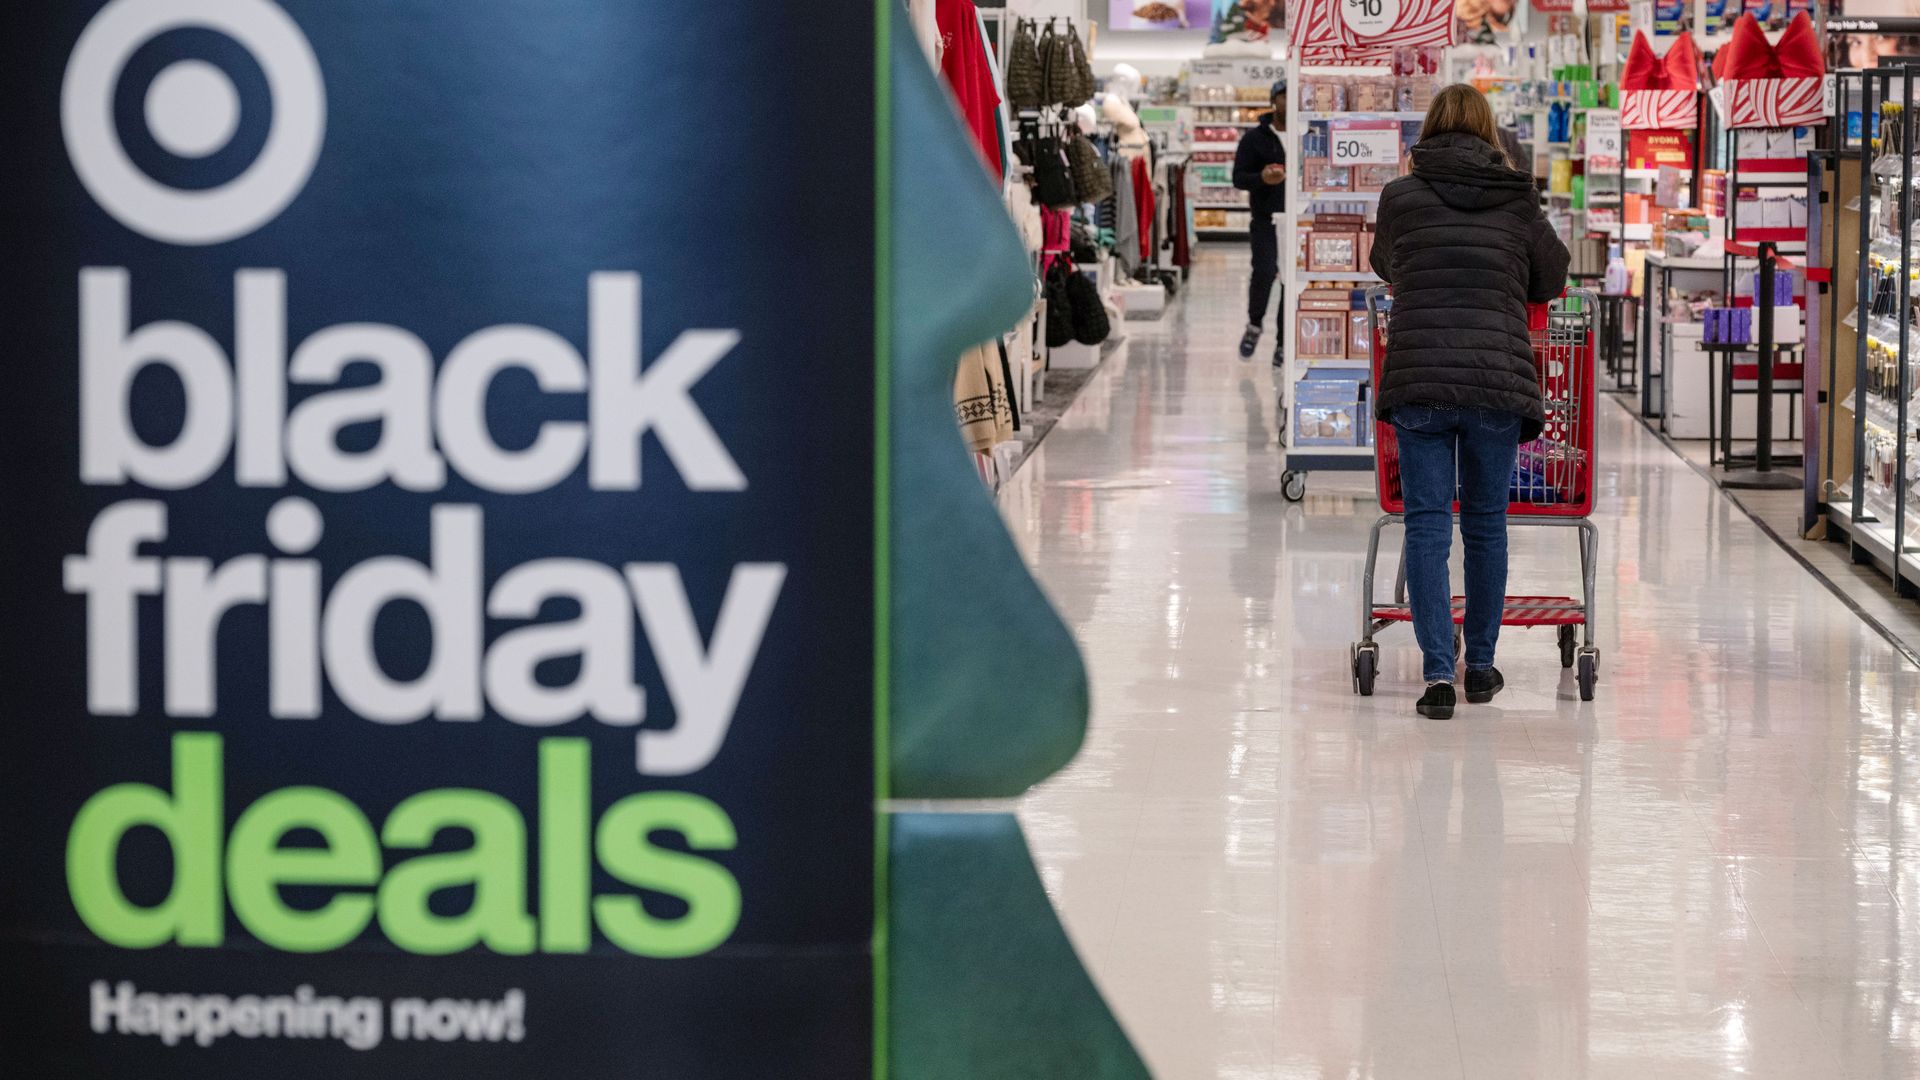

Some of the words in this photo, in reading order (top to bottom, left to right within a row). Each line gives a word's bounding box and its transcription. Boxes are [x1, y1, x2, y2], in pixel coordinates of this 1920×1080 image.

[1361, 150, 1373, 158] off
[78, 266, 748, 494] black
[62, 496, 788, 776] friday
[65, 731, 743, 959] deals
[90, 979, 383, 1050] Happening
[391, 988, 526, 1043] now!
